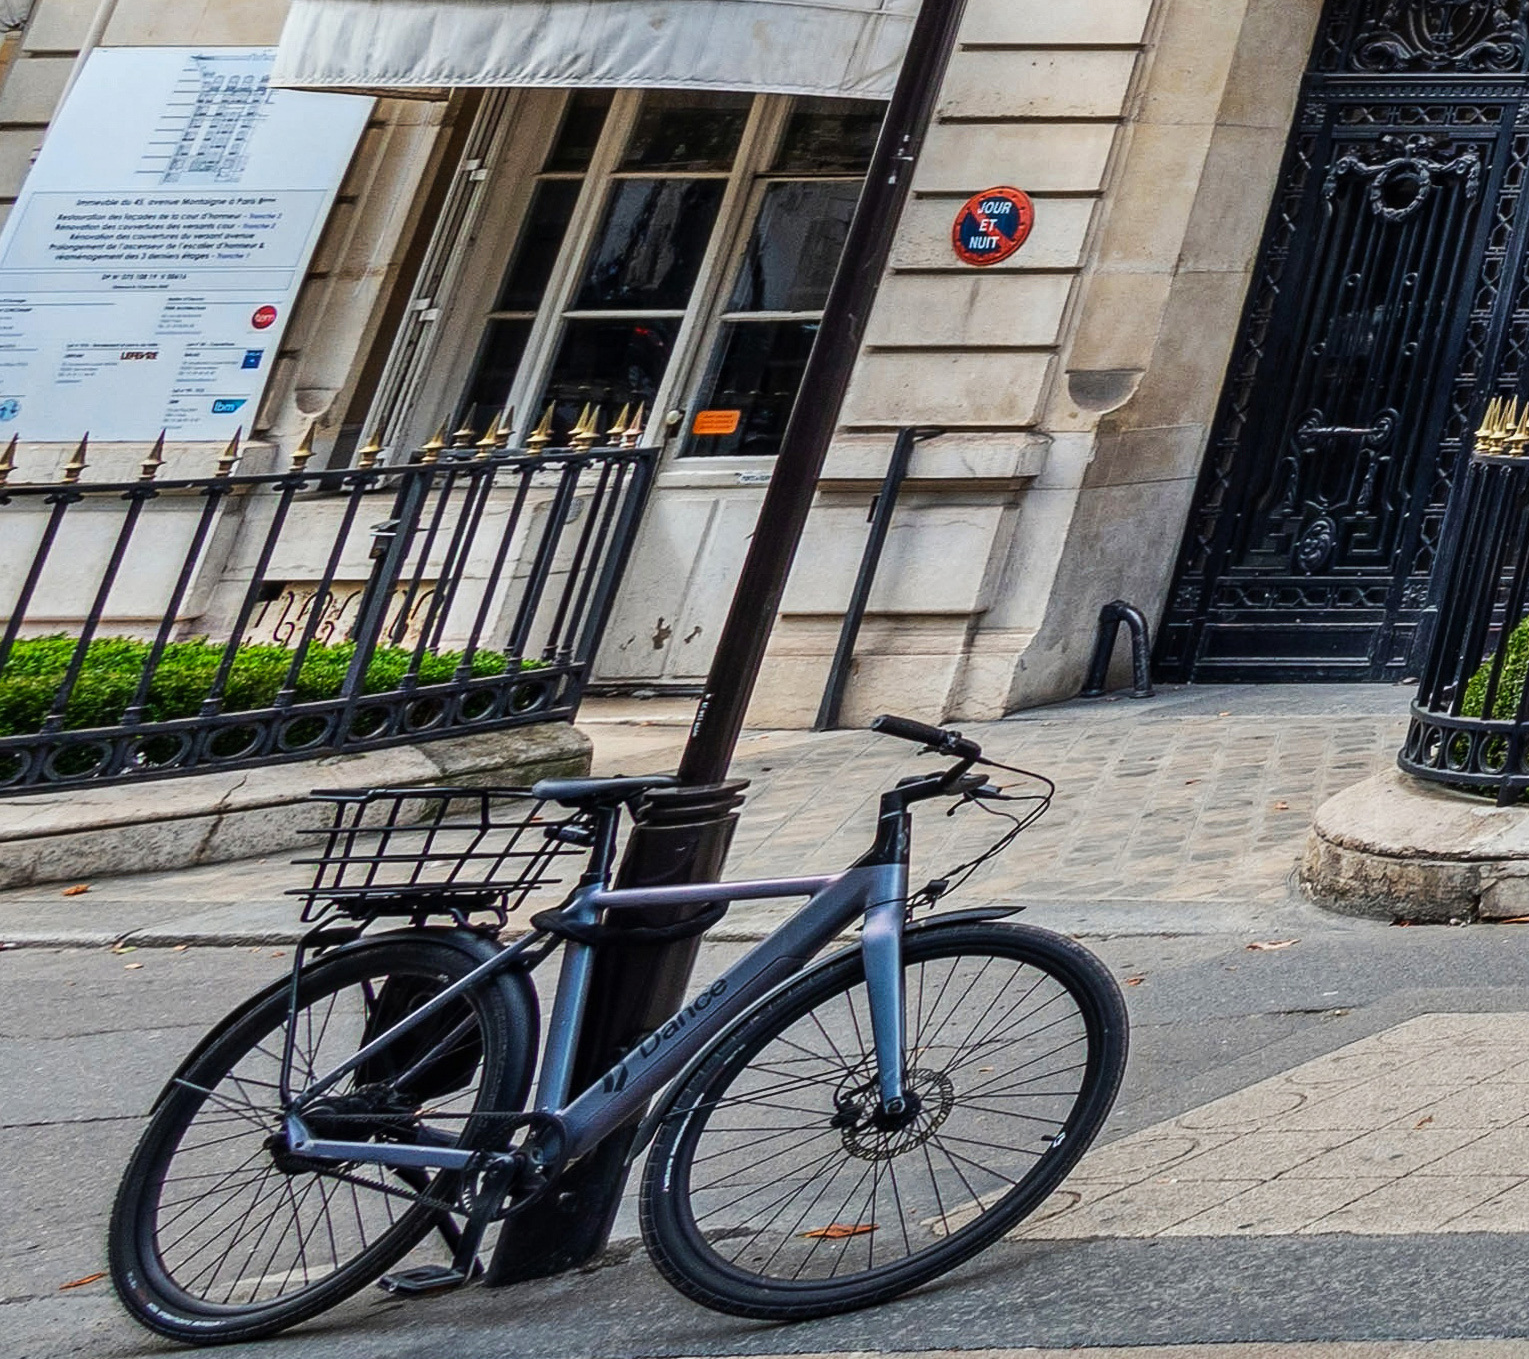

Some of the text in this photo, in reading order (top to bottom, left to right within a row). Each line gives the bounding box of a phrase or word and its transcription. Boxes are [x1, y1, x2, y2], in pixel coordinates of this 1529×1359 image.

[977, 201, 1012, 214] JOUR
[979, 218, 998, 232] ET
[968, 236, 1000, 249] NUIT
[640, 978, 727, 1059] Dance
